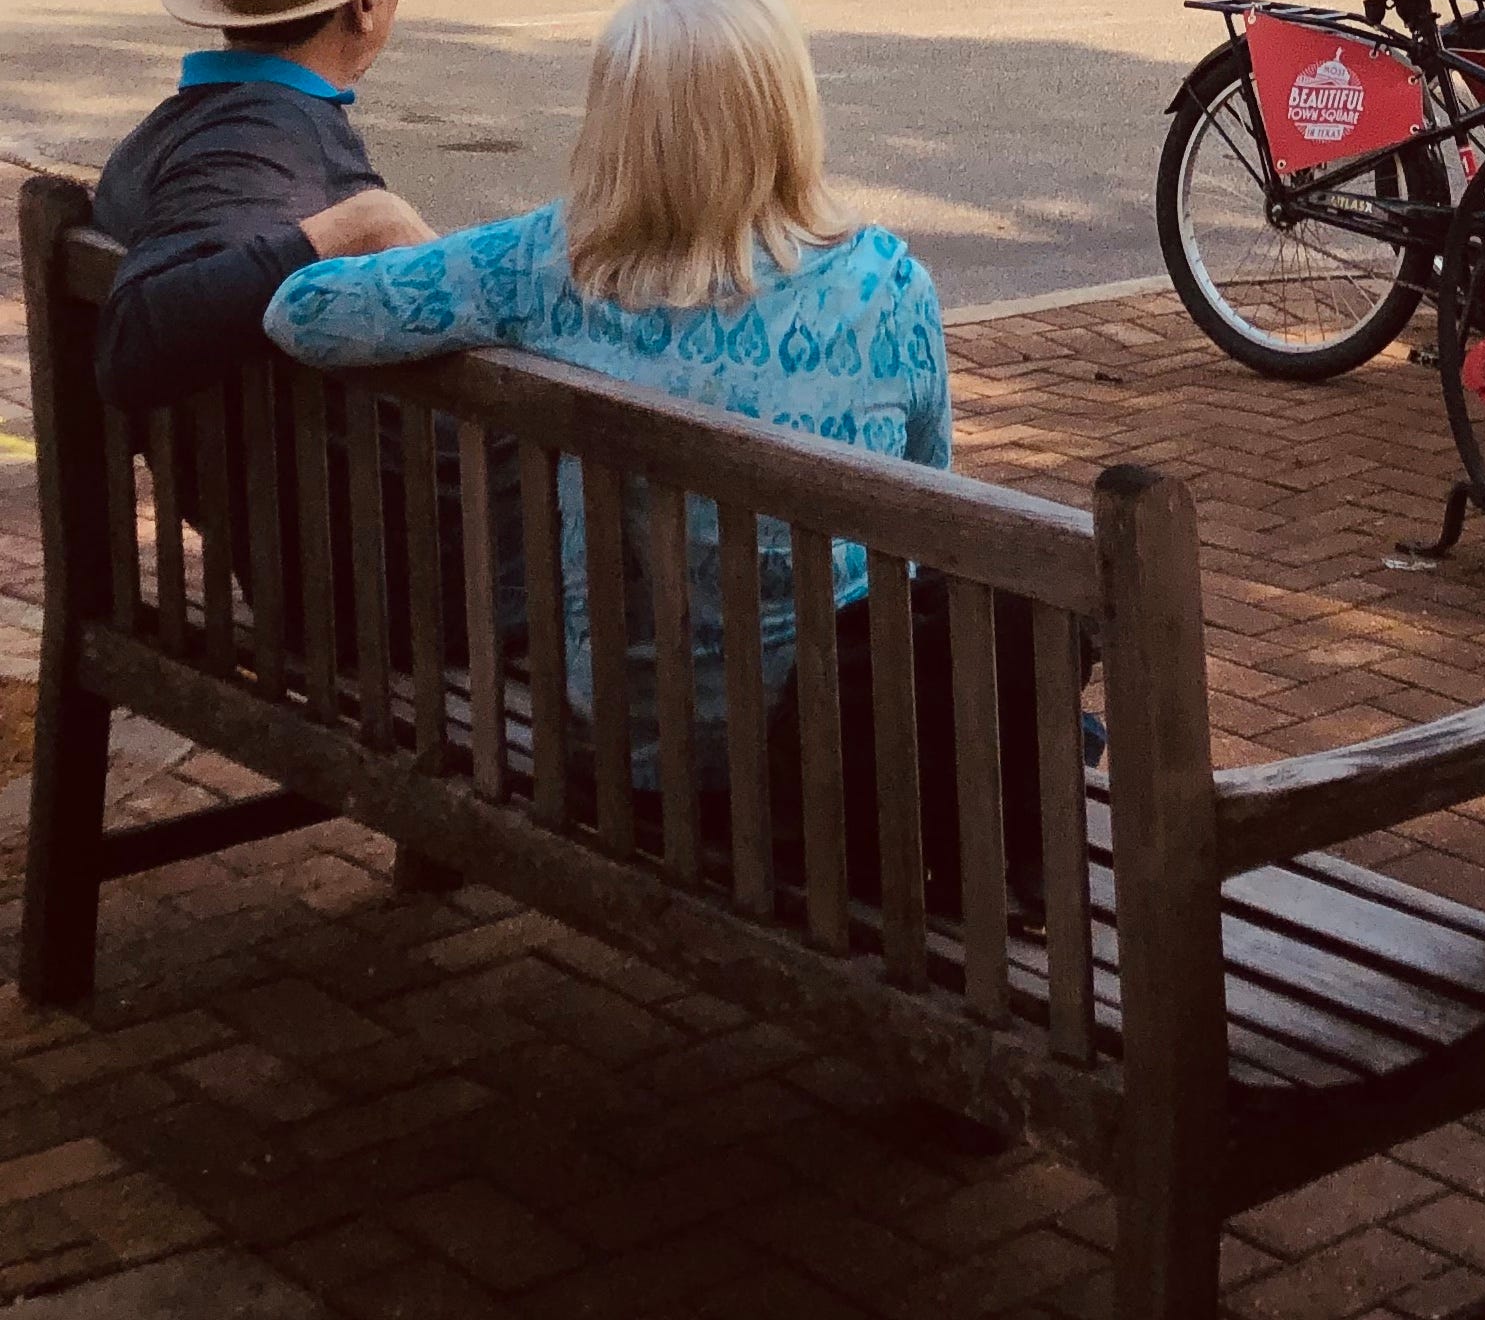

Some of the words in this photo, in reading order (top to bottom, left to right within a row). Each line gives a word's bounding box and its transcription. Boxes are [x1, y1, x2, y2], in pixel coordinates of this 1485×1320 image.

[1288, 87, 1365, 111] BEAUTIFUL
[1287, 107, 1318, 121] TOWN
[1319, 108, 1360, 125] SQUARE
